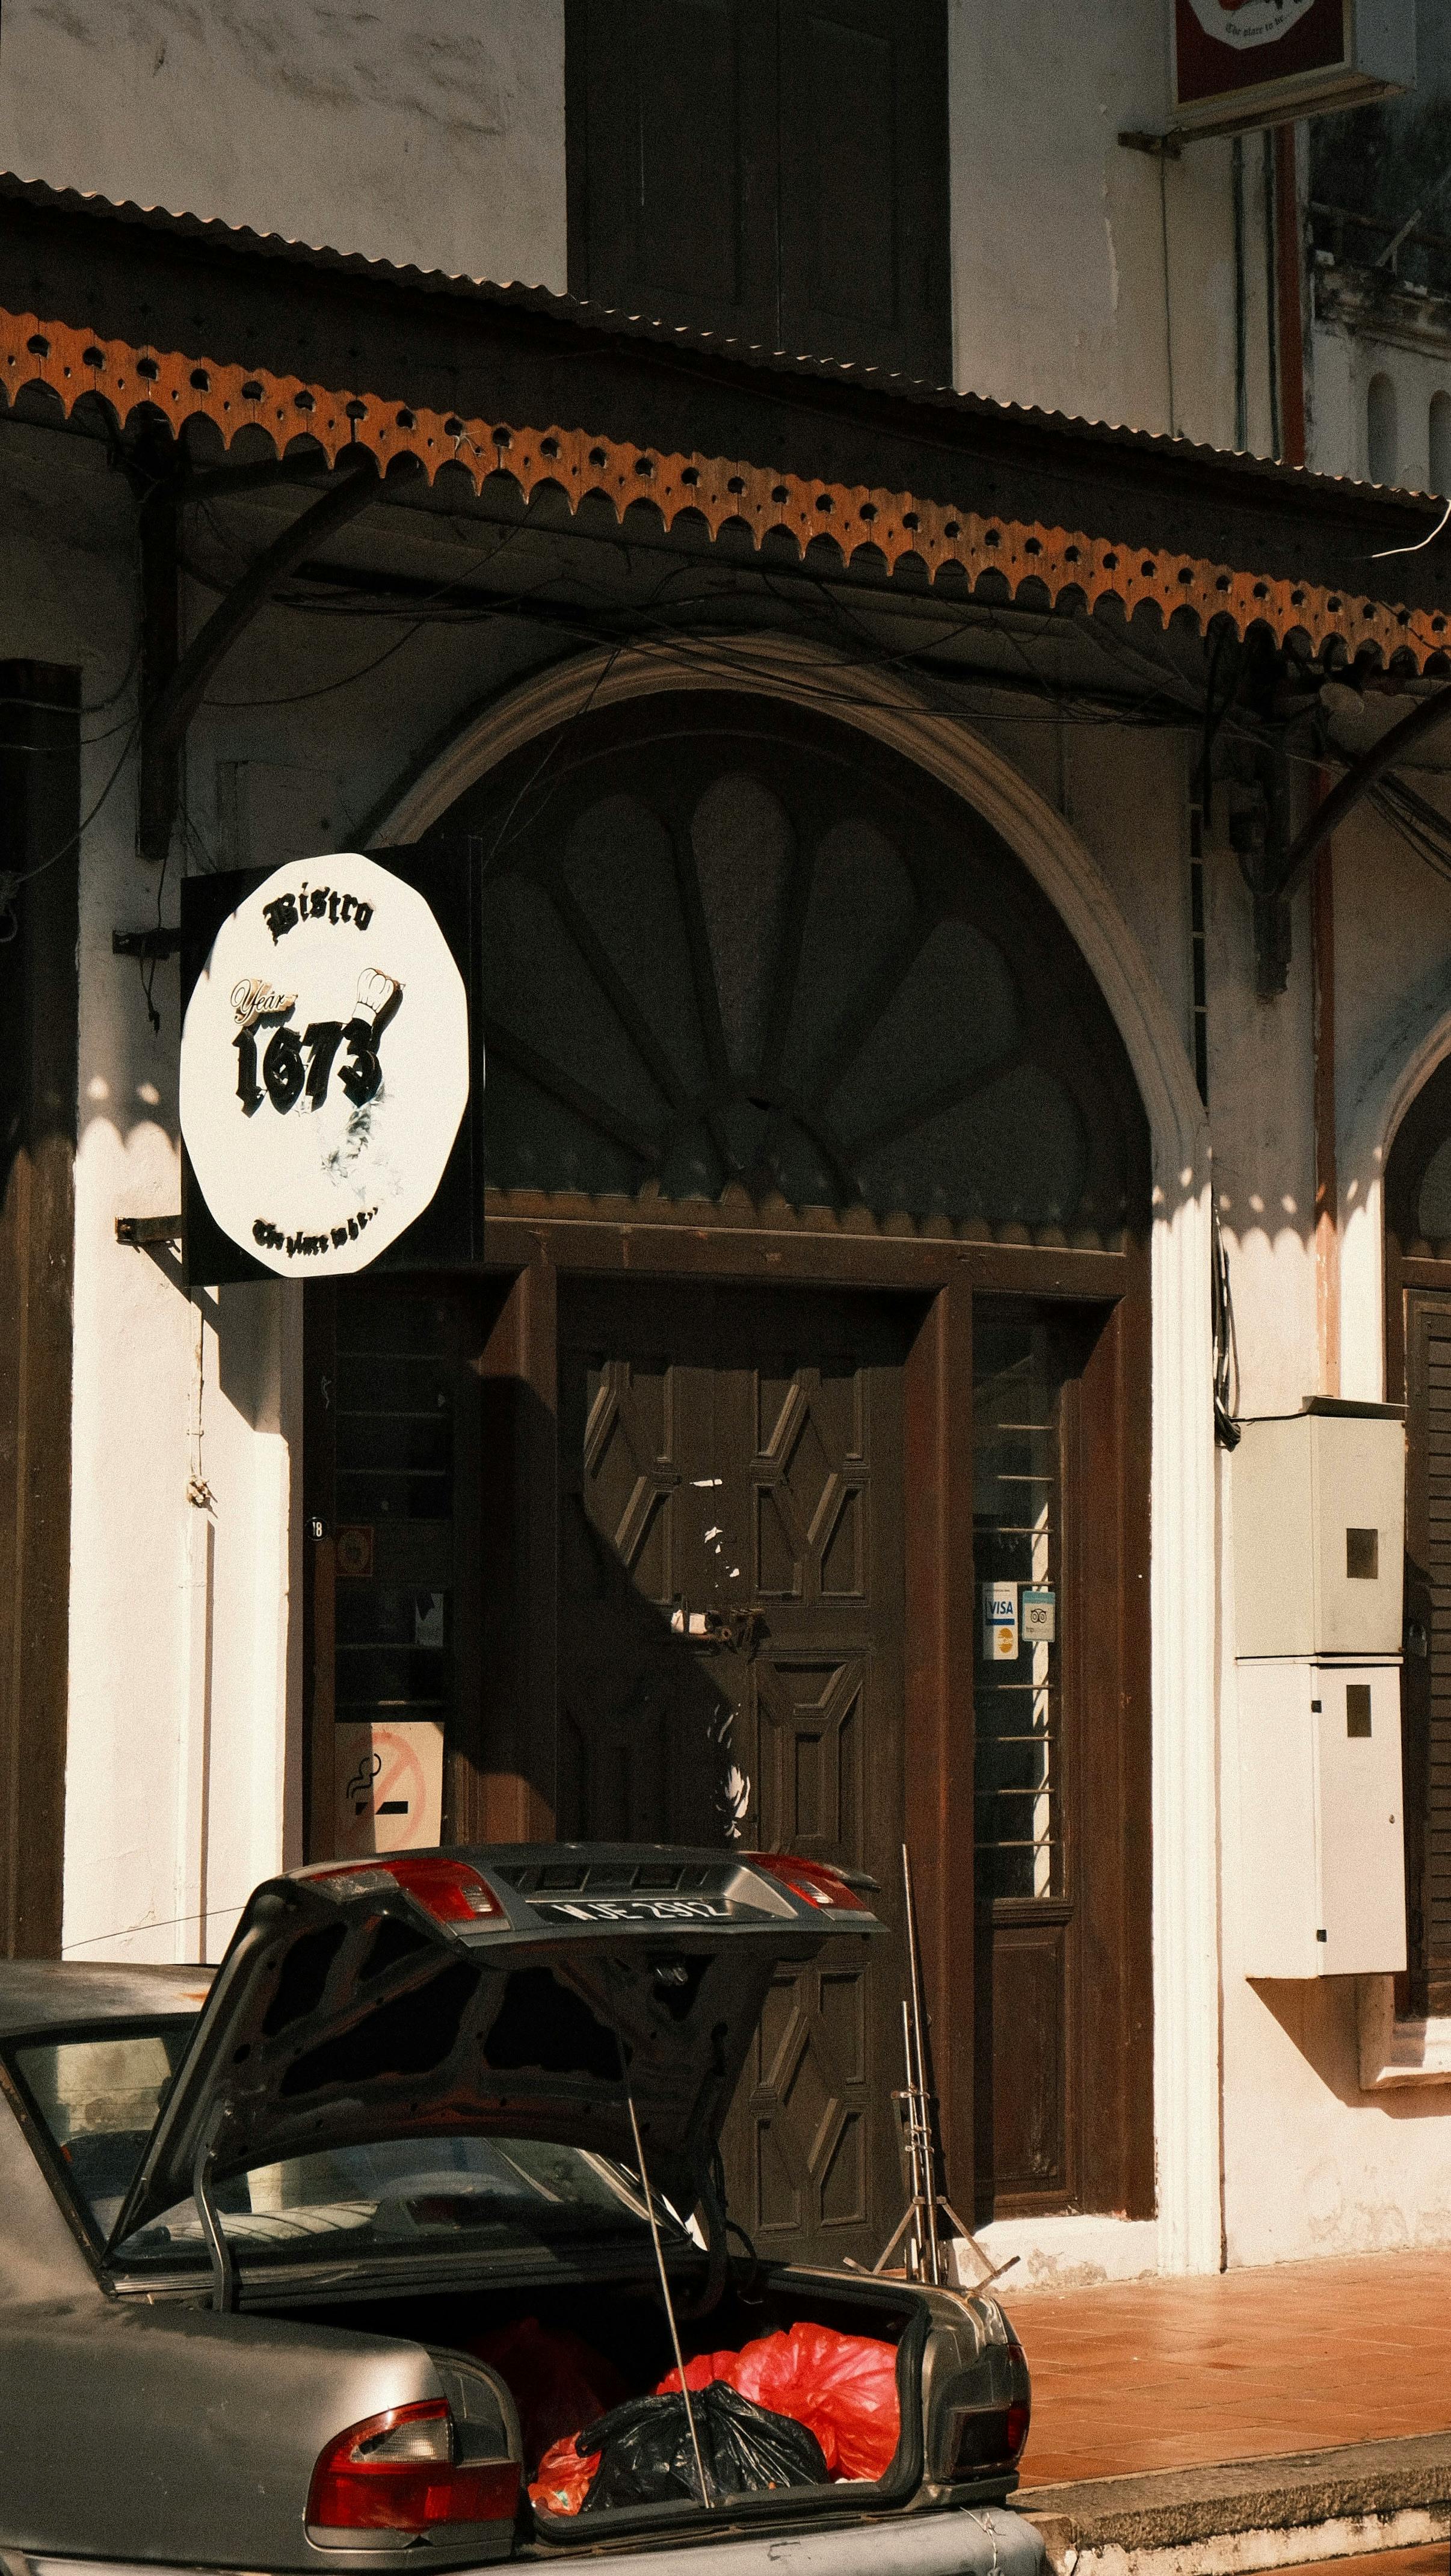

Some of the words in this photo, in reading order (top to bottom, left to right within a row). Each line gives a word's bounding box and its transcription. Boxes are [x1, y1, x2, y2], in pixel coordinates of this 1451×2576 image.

[1225, 23, 1241, 36] The
[1243, 26, 1263, 37] place
[263, 883, 374, 946] Bistro
[232, 1018, 381, 1118] 1673
[312, 1521, 323, 1538] 18
[988, 1601, 1013, 1615] VISA
[550, 1903, 645, 1921] WJE
